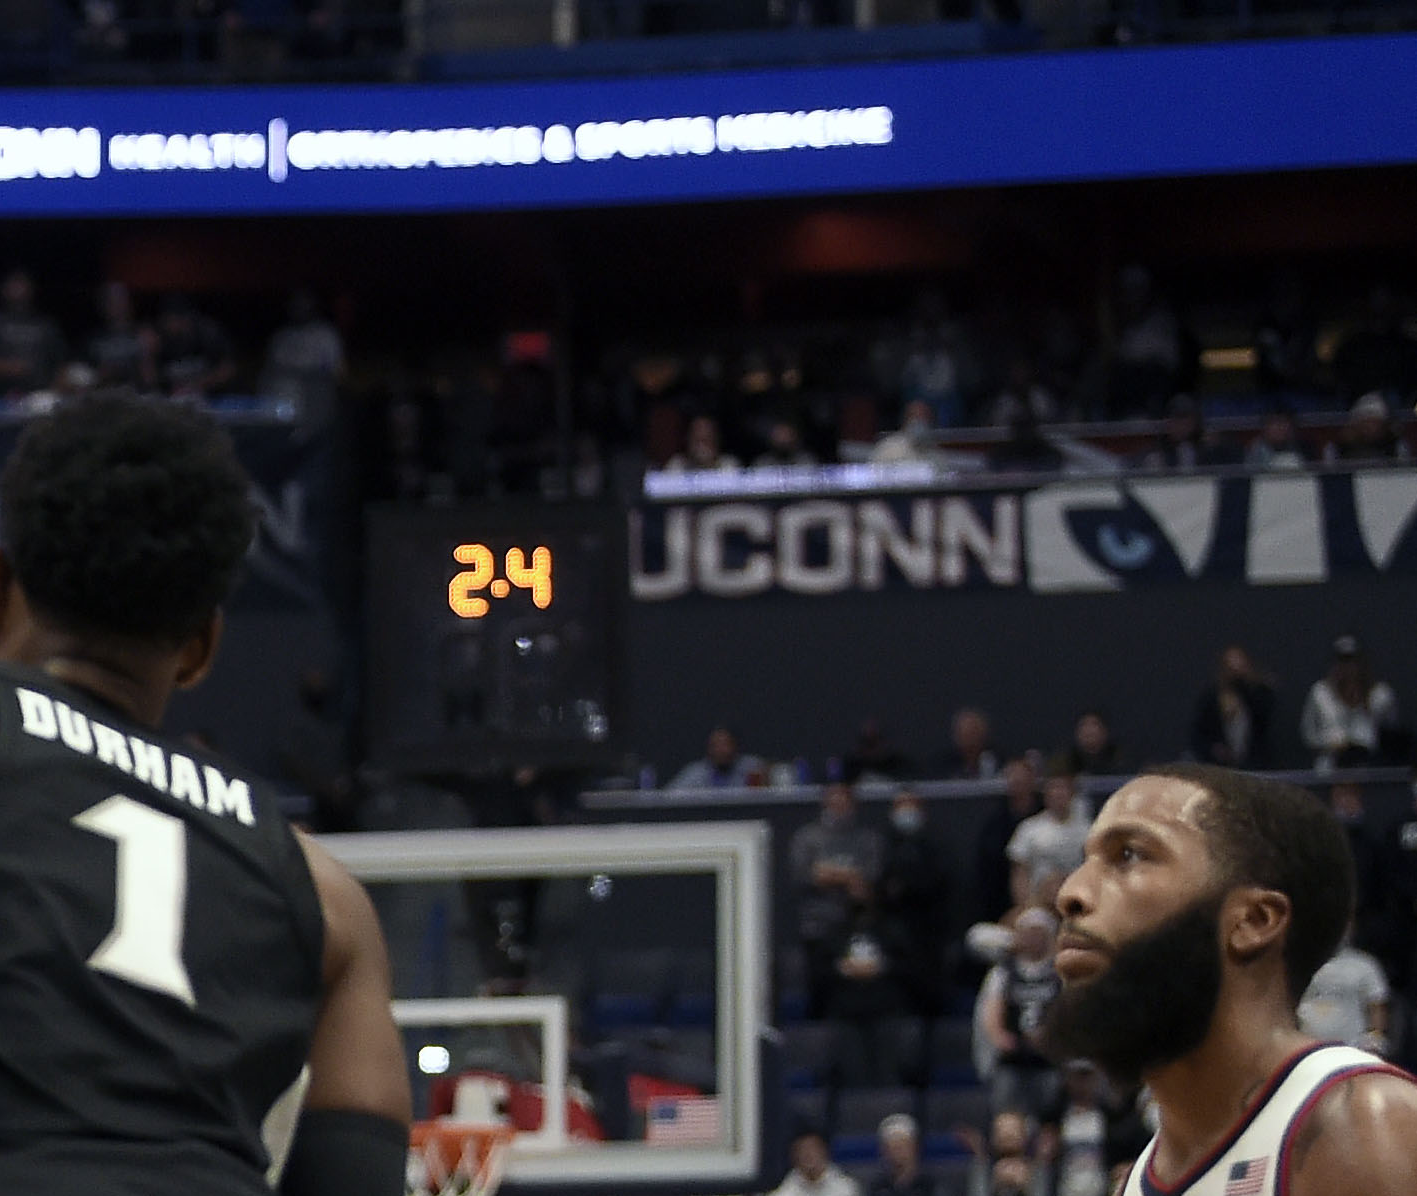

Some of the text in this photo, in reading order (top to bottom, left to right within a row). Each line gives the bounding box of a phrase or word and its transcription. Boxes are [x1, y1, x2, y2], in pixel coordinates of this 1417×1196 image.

[108, 132, 266, 170] HEALTH
[448, 543, 553, 620] 2.4
[628, 496, 1021, 599] UCONN
[15, 687, 257, 827] DURHAM
[70, 794, 198, 1011] 1
